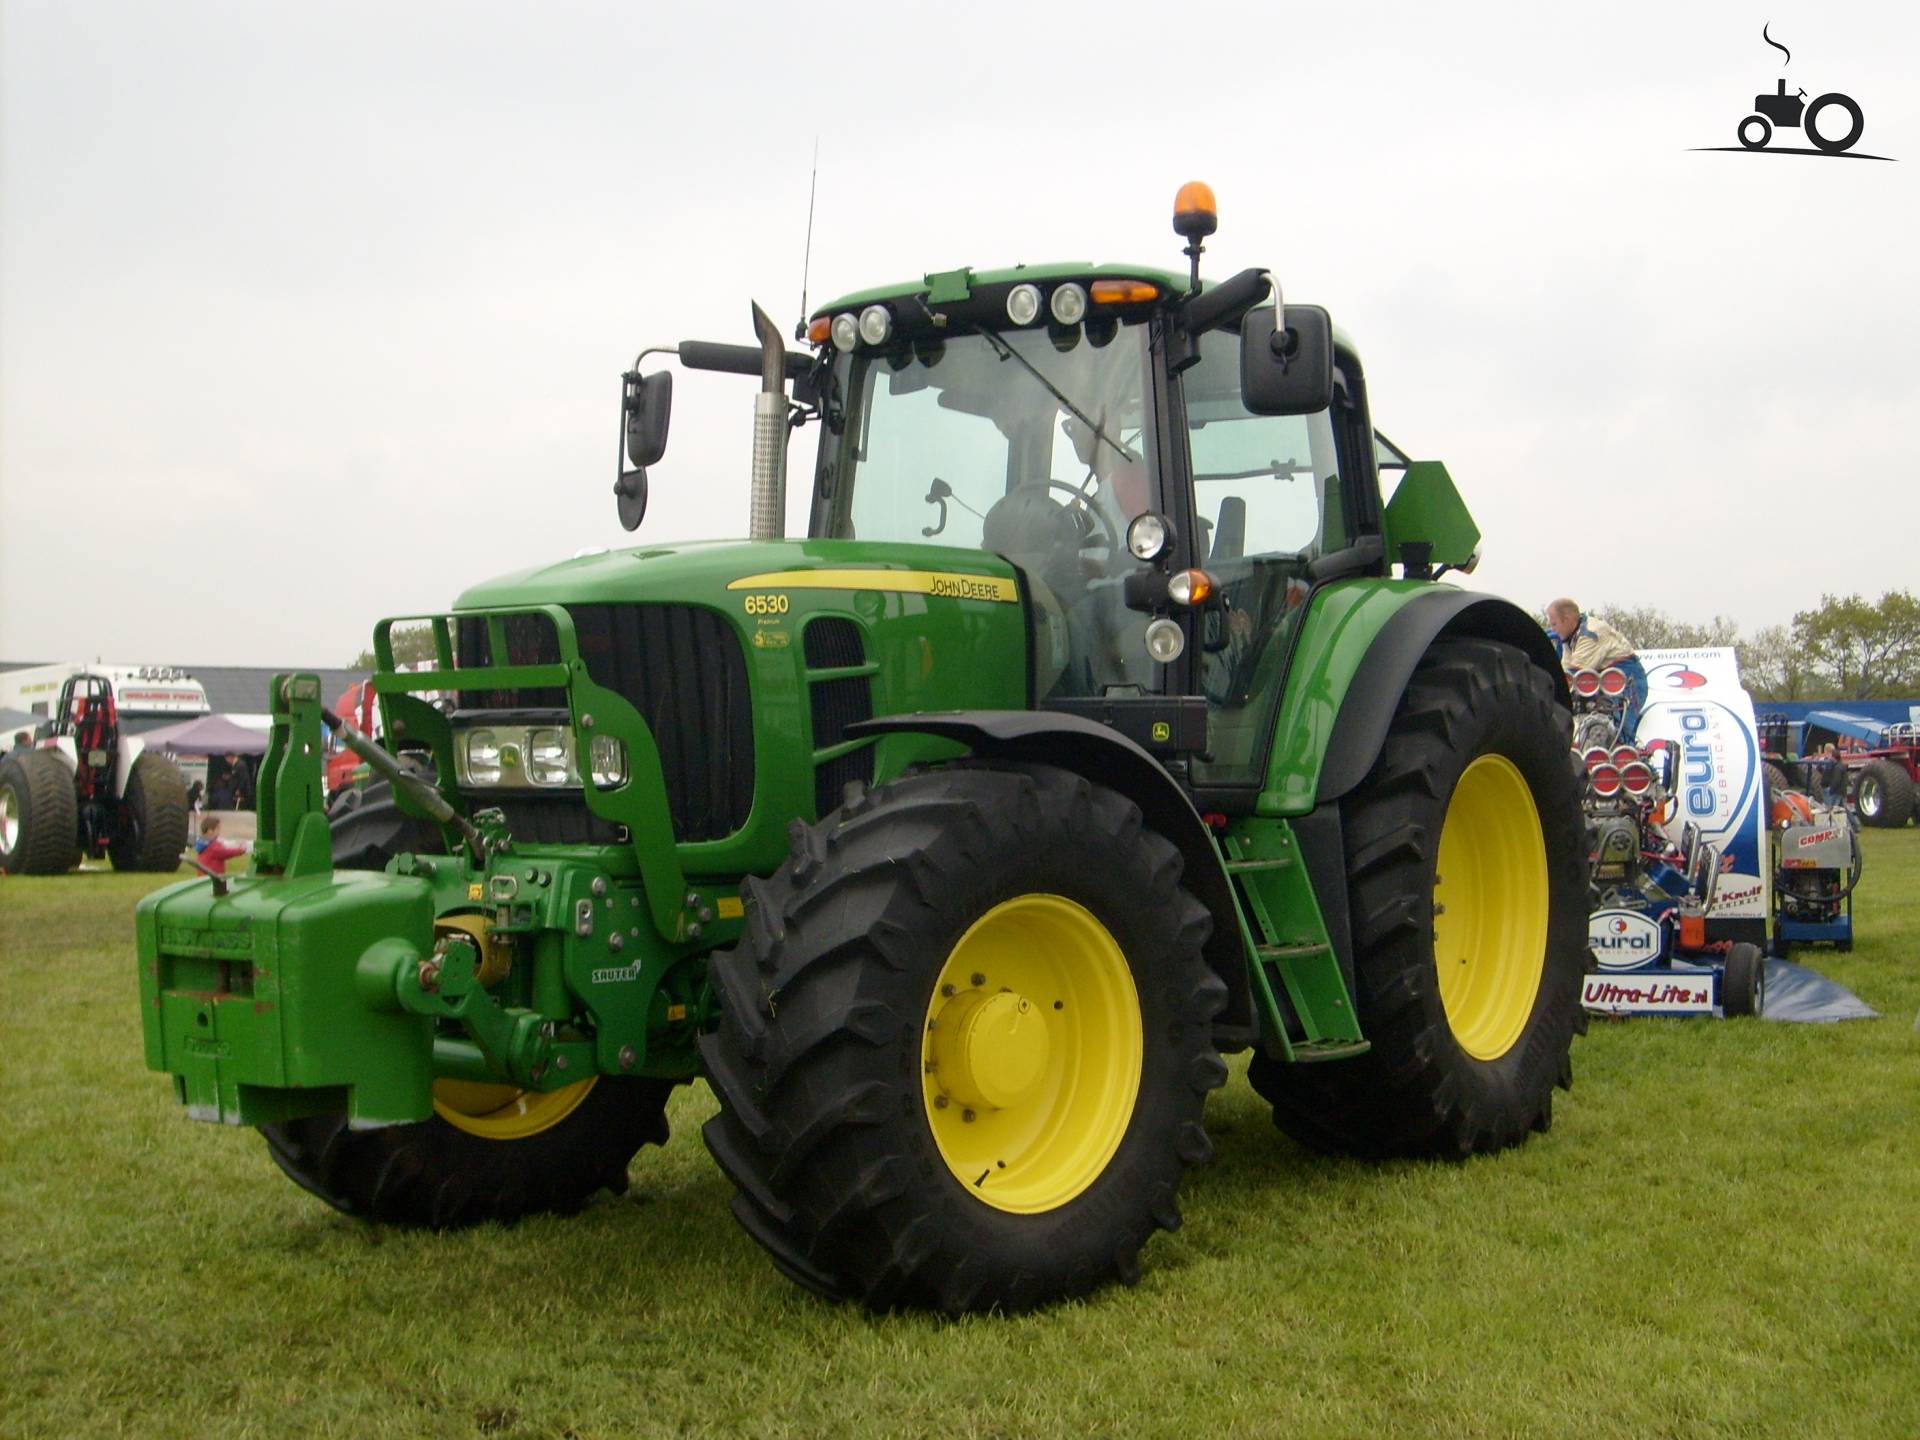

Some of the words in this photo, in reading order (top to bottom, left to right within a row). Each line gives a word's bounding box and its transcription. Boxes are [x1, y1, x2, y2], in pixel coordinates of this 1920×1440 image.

[960, 579, 1000, 599] DEERE
[744, 594, 789, 615] 6530
[1668, 707, 1716, 817] eurol
[1588, 933, 1650, 949] eurol
[592, 966, 636, 984] SAUTER
